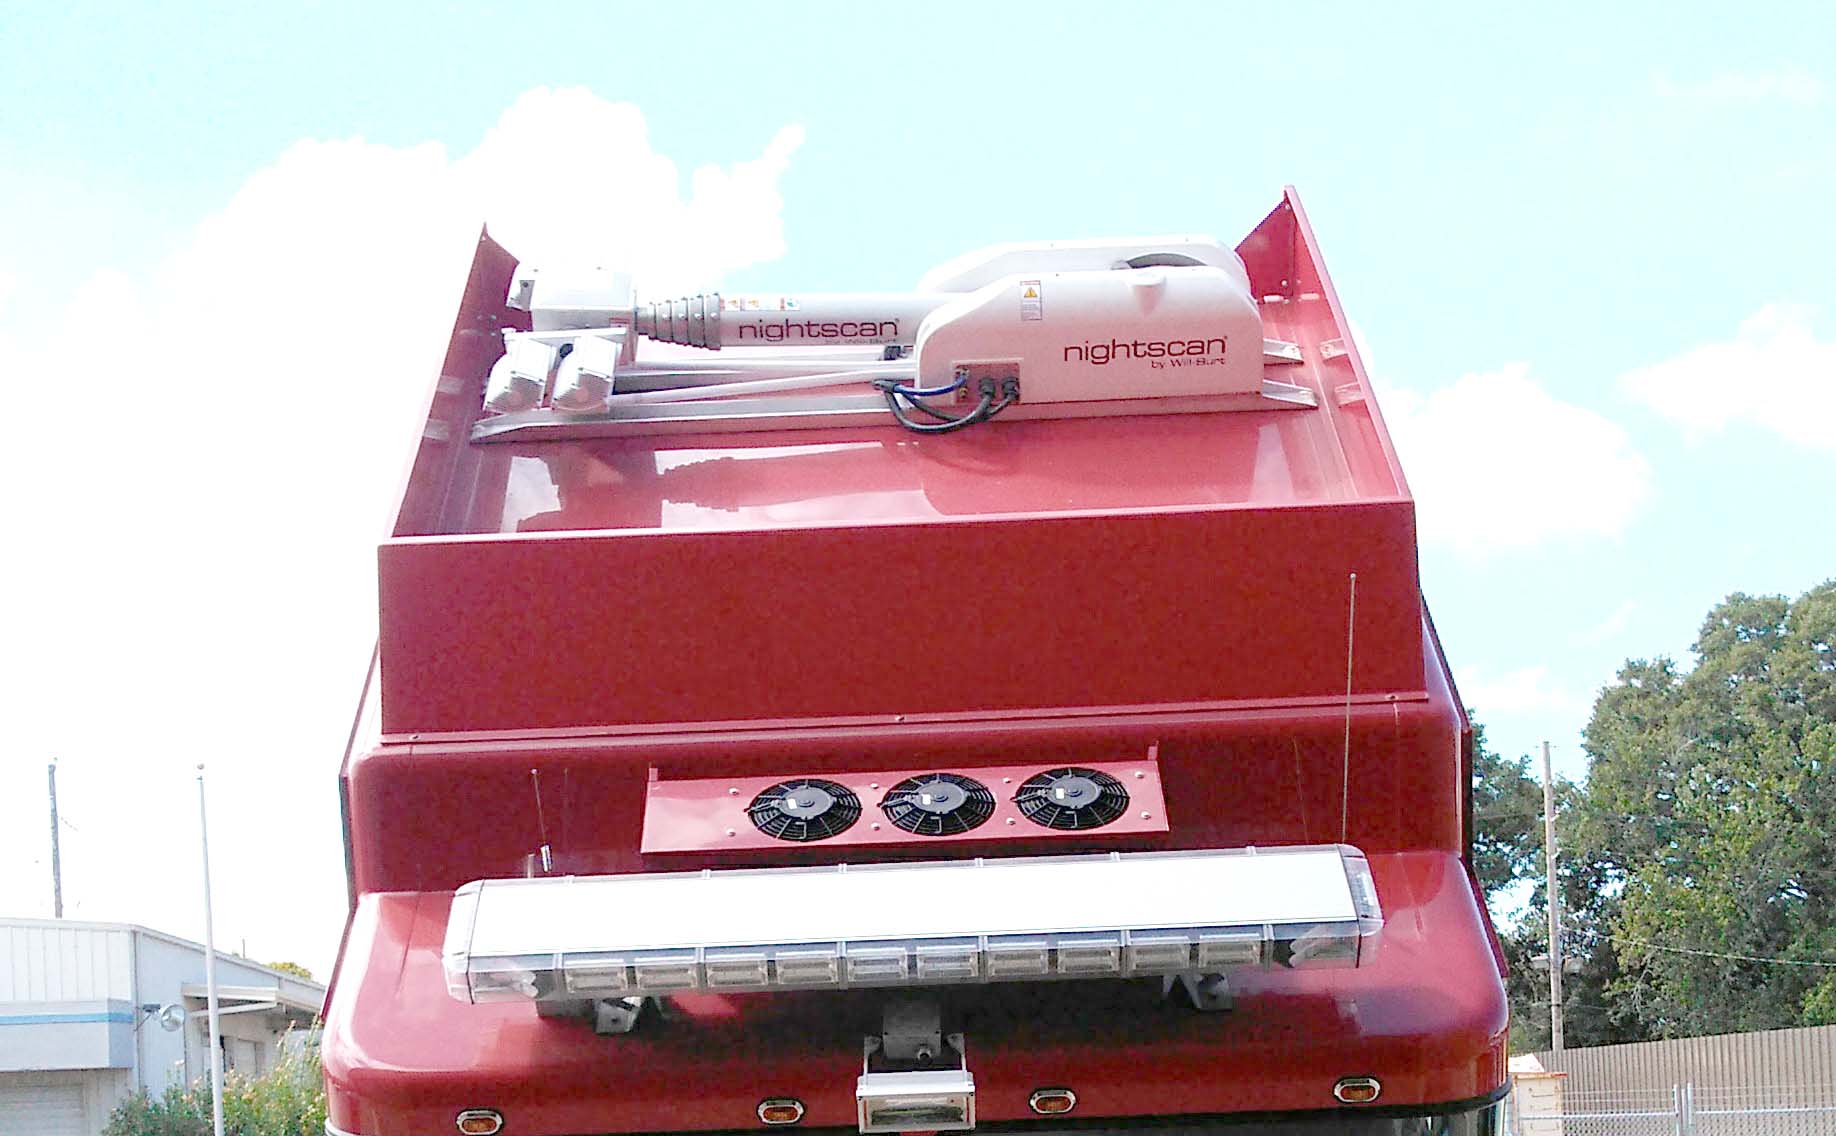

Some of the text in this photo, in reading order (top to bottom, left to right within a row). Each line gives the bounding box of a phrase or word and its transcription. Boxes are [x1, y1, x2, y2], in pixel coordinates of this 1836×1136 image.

[738, 318, 898, 342] nightscan
[1063, 338, 1226, 365] nightscan
[1151, 360, 1166, 369] by
